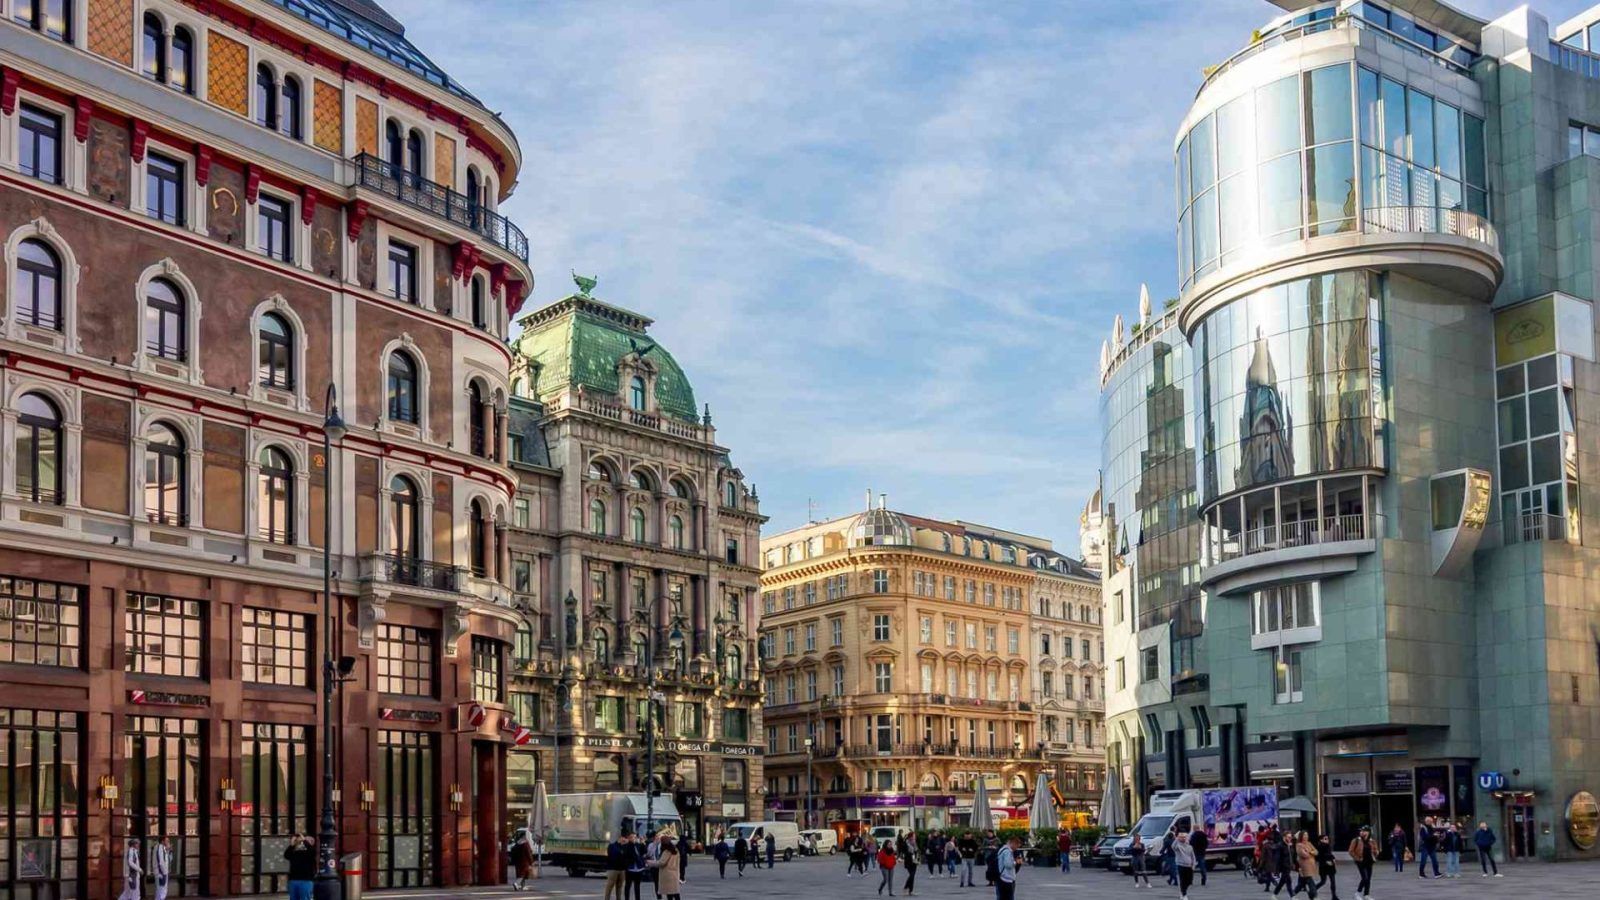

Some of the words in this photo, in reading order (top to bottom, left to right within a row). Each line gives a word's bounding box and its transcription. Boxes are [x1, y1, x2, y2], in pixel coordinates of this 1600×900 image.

[677, 742, 701, 752] OMEGA
[725, 746, 747, 755] OMEGA
[1480, 776, 1491, 788] U
[1495, 776, 1503, 788] U
